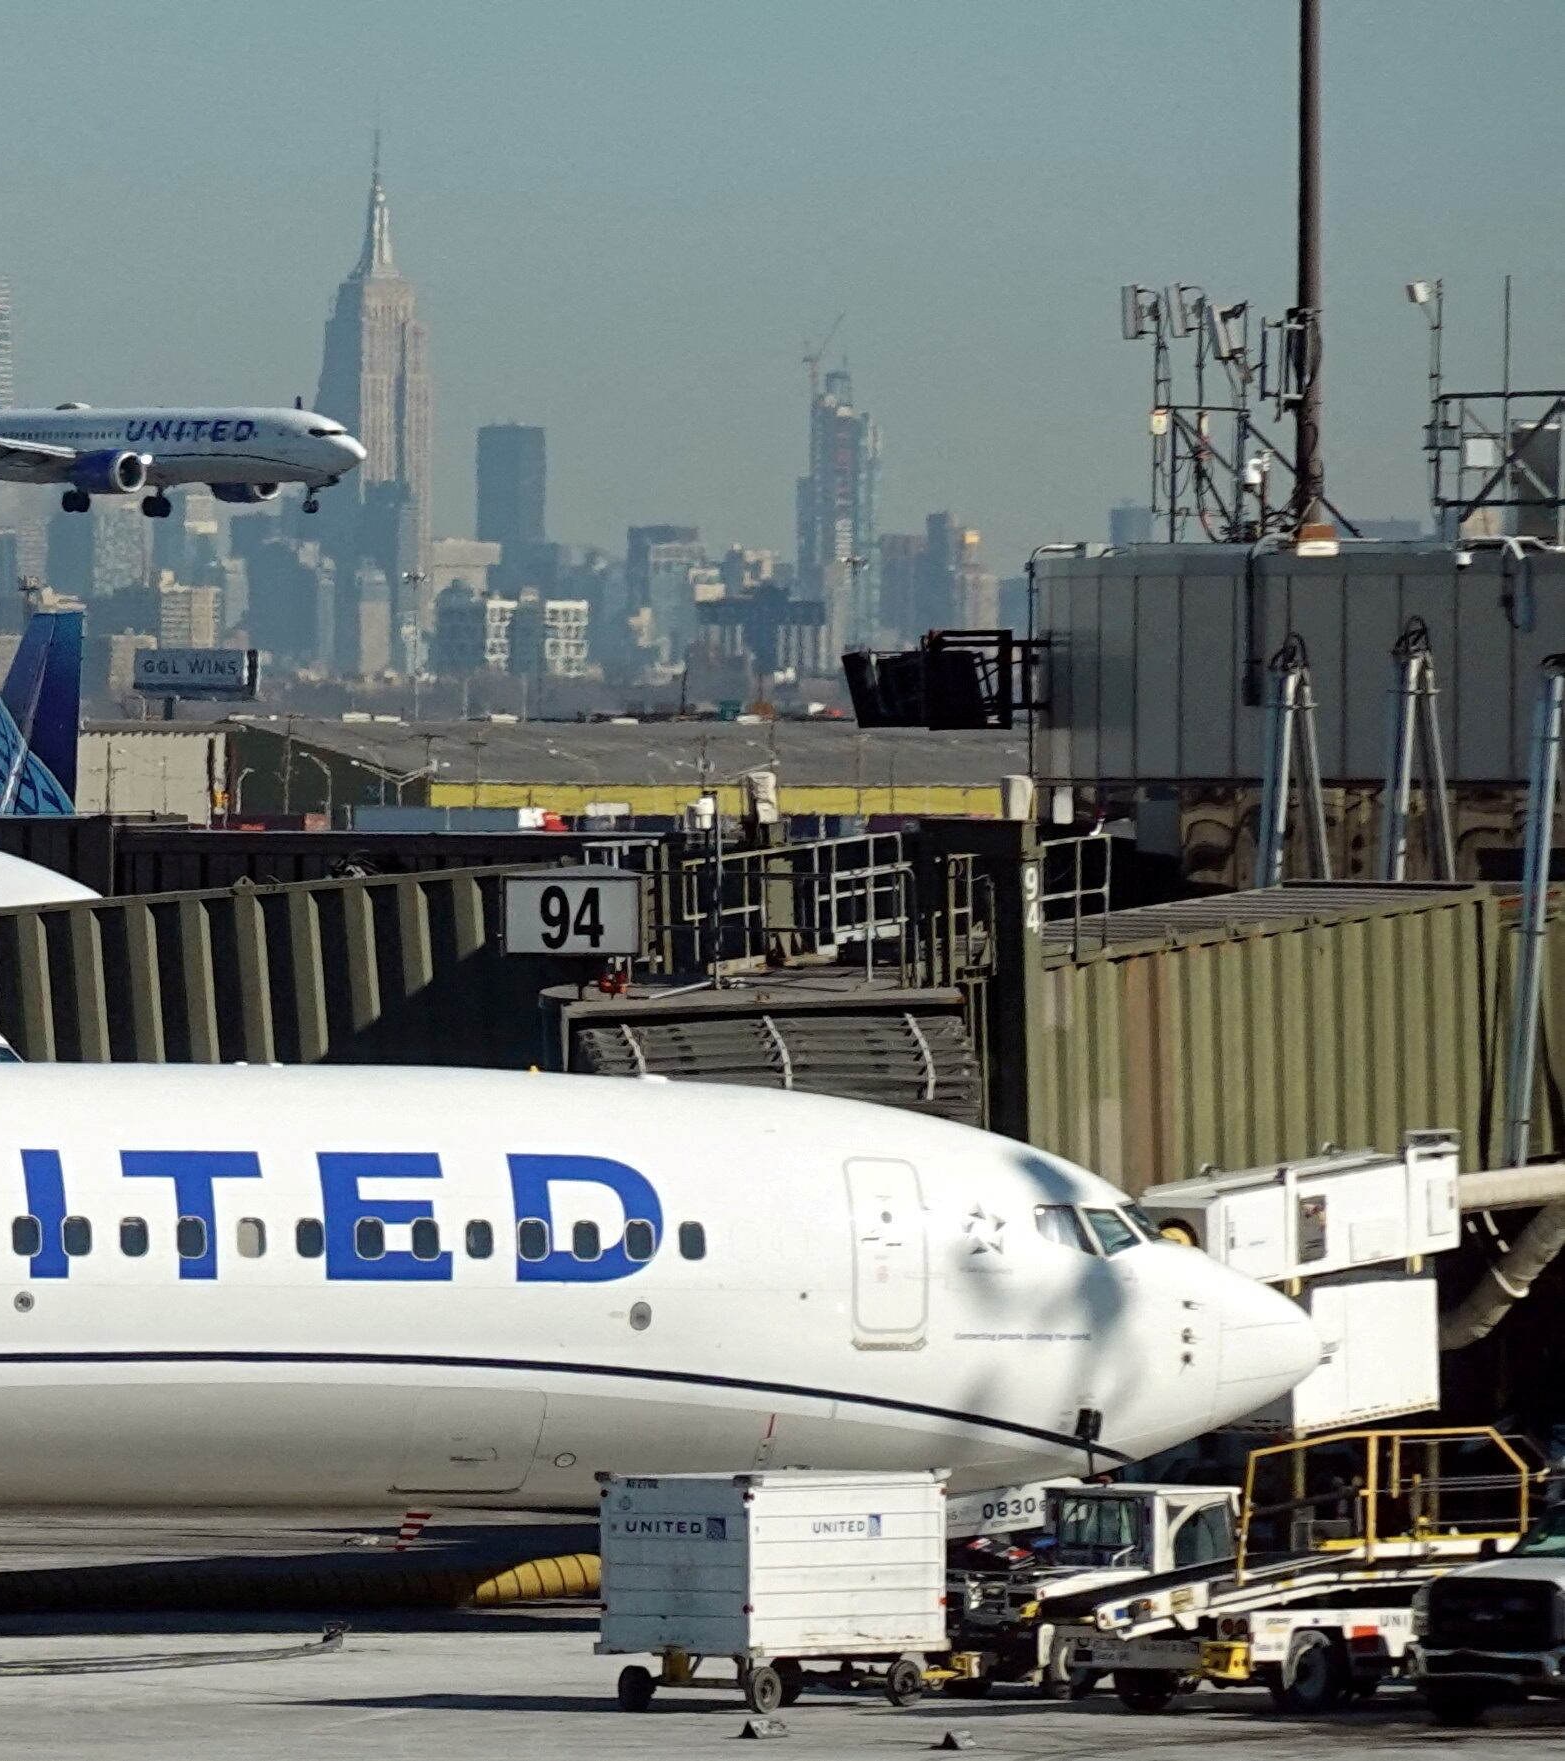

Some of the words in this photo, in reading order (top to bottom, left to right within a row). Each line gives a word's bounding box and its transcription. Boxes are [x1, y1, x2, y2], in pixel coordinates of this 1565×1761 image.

[127, 420, 254, 441] UNITED
[540, 885, 604, 949] 94
[625, 1521, 702, 1534] UNITED
[813, 1520, 865, 1533] UNITED
